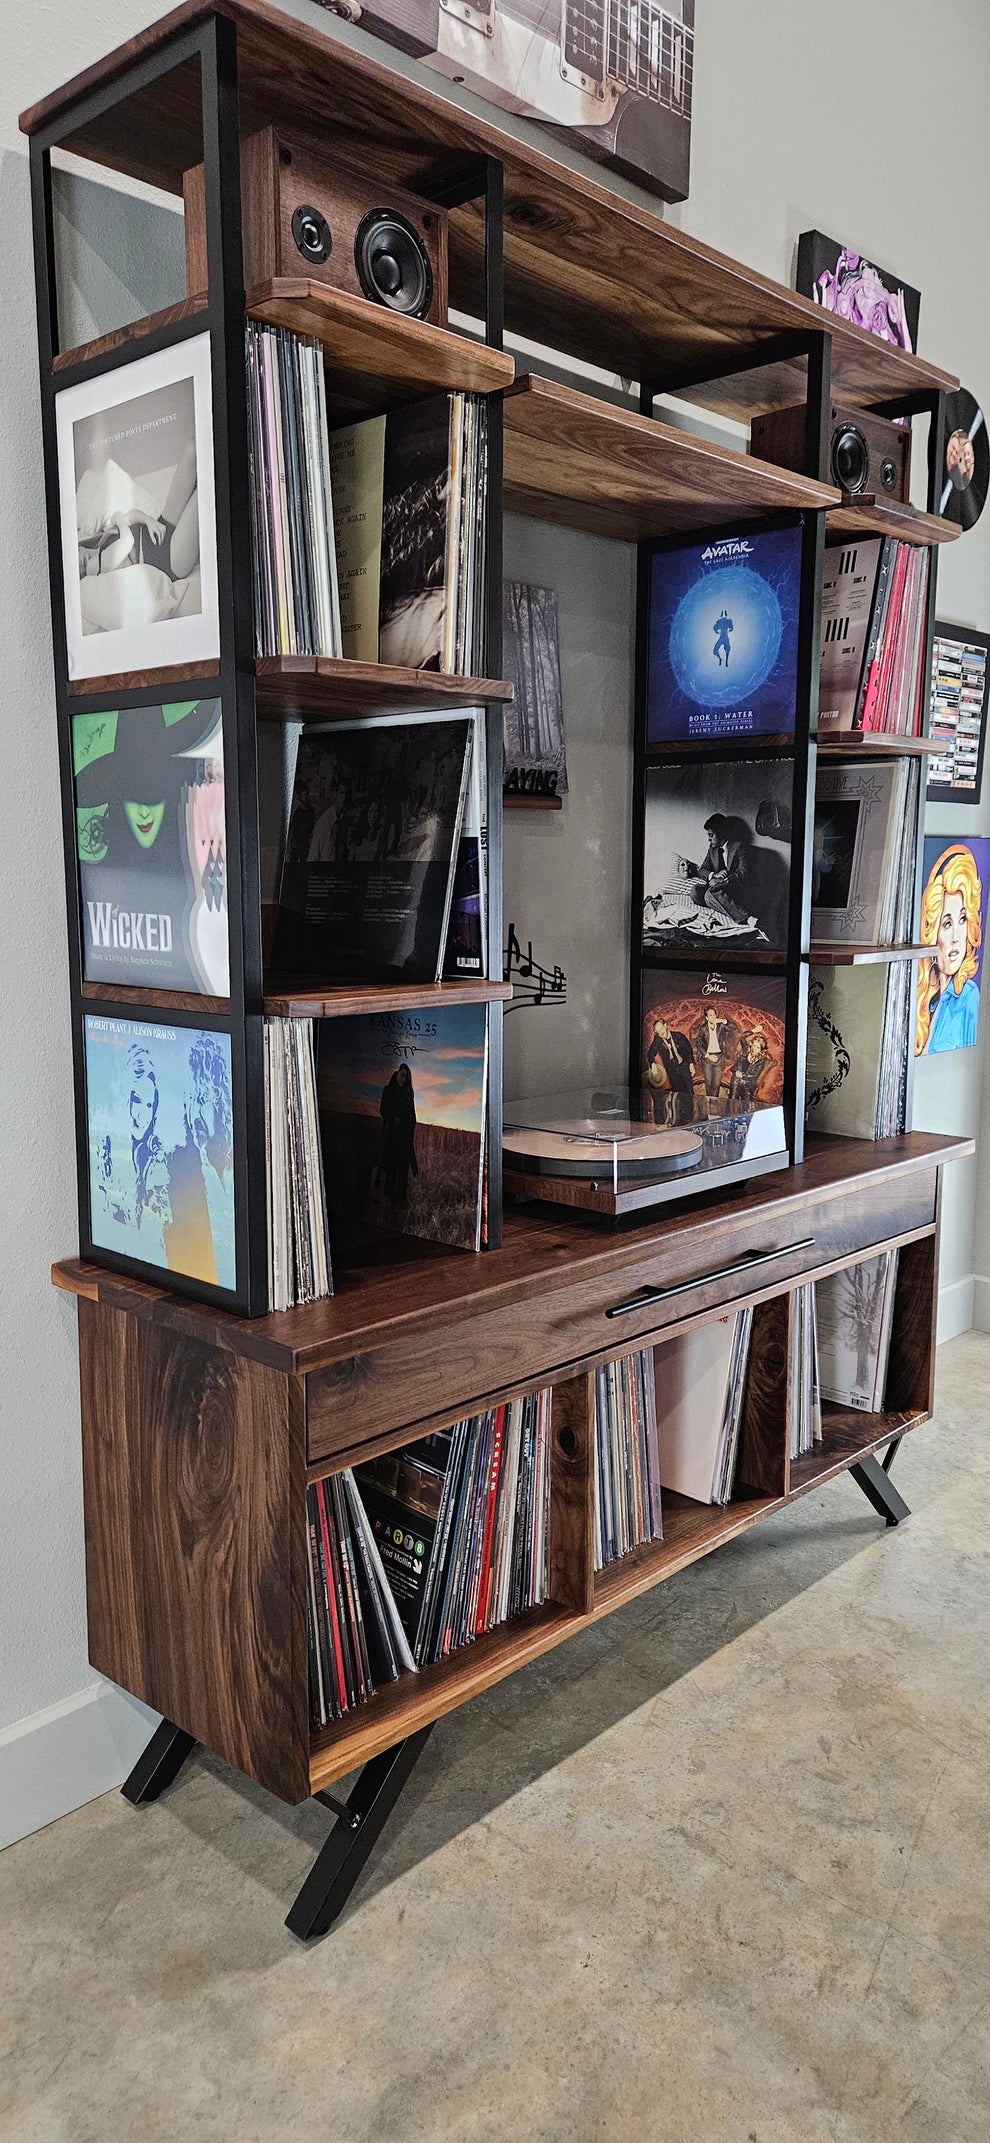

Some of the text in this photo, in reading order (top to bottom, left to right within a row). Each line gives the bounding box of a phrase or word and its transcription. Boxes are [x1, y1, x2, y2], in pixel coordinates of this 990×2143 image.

[125, 426, 142, 437] POETS
[142, 413, 177, 431] DEPARTMENT
[701, 541, 755, 560] AVATAR
[724, 710, 753, 719] WATER
[504, 767, 559, 791] AYING
[87, 1019, 176, 1040] ROBERT PLANT ALISON KRAUSS
[369, 1015, 421, 1031] KANSAS
[425, 1022, 437, 1036] 25
[490, 1432, 501, 1491] SCREAM
[380, 1545, 394, 1558] Fred
[394, 1552, 412, 1568] Mollin
